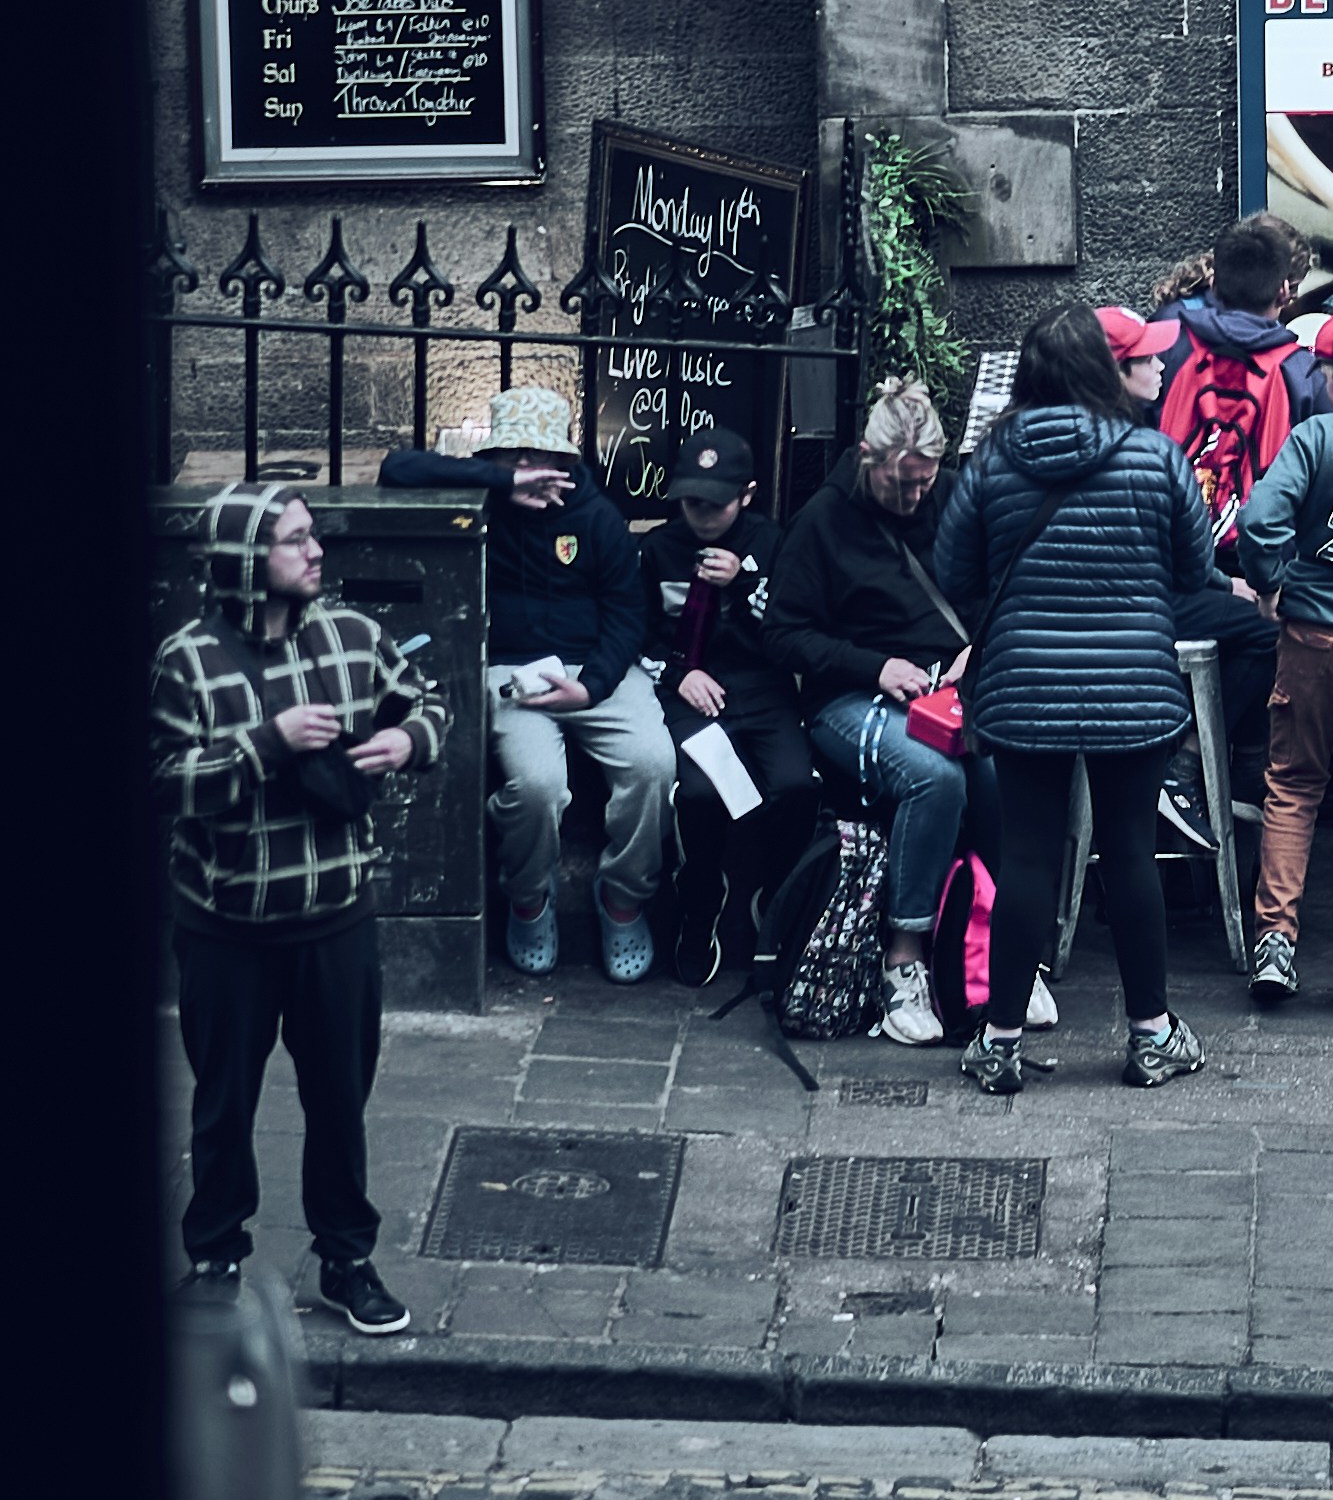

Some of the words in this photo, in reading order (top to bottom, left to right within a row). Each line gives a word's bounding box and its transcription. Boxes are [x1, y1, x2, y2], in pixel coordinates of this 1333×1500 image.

[262, 27, 293, 50] Fri
[263, 96, 304, 126] Sun
[631, 163, 713, 278] Monday
